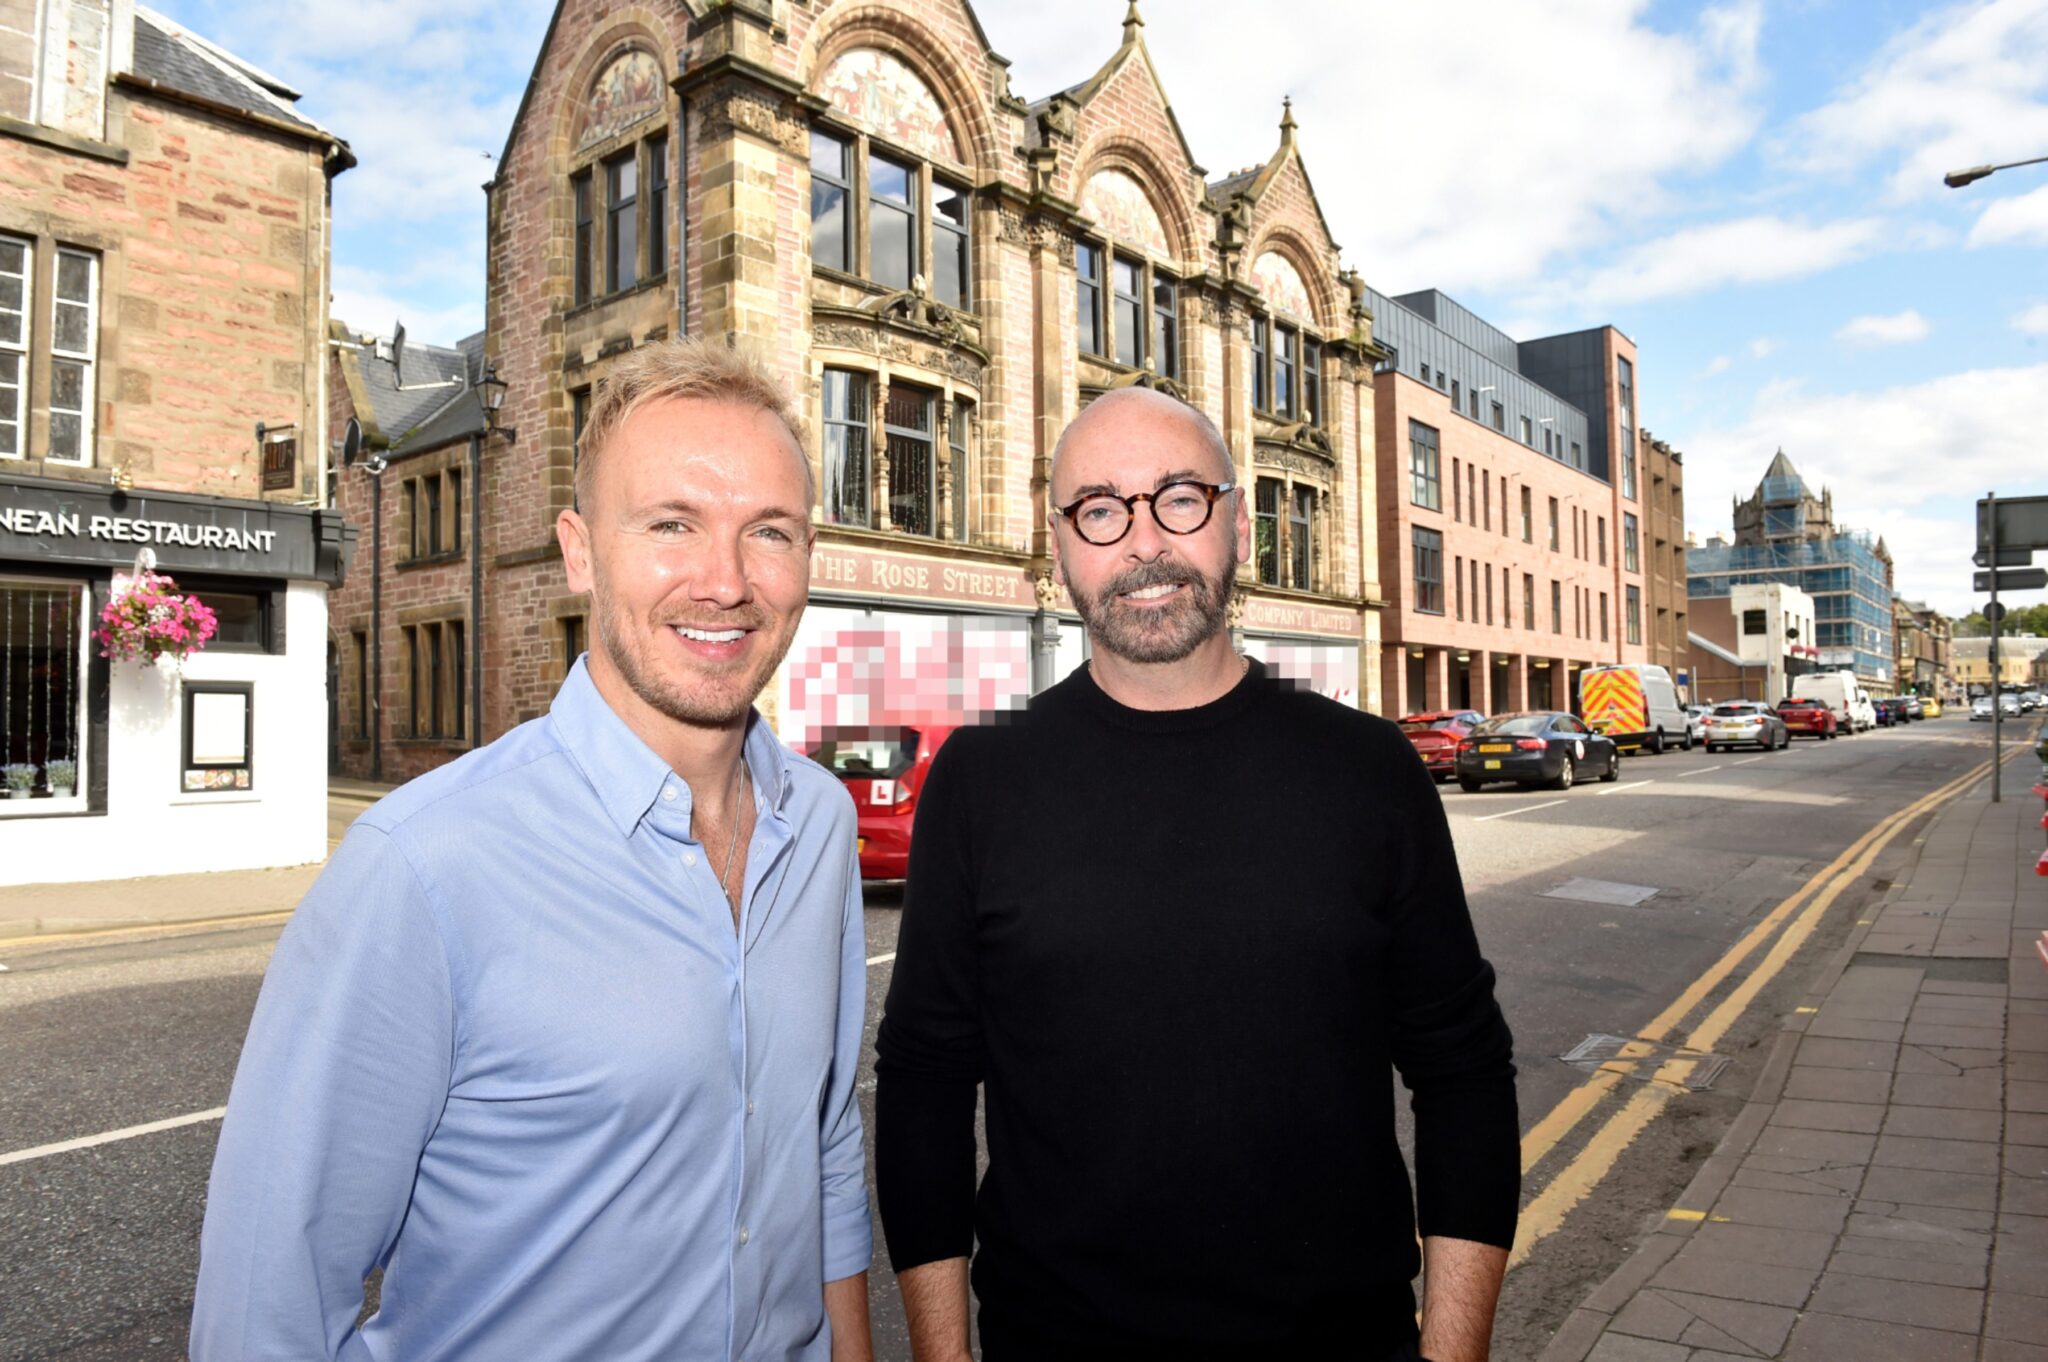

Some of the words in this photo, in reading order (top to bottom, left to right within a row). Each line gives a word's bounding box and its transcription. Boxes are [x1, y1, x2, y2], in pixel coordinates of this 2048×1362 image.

[89, 516, 276, 552] RESTAURANT
[811, 552, 857, 583] THE
[872, 559, 929, 589] ROSE
[943, 567, 1019, 598] STREET
[1247, 603, 1303, 626] COMPANY
[1311, 610, 1352, 631] LIMITED
[877, 785, 888, 800] L
